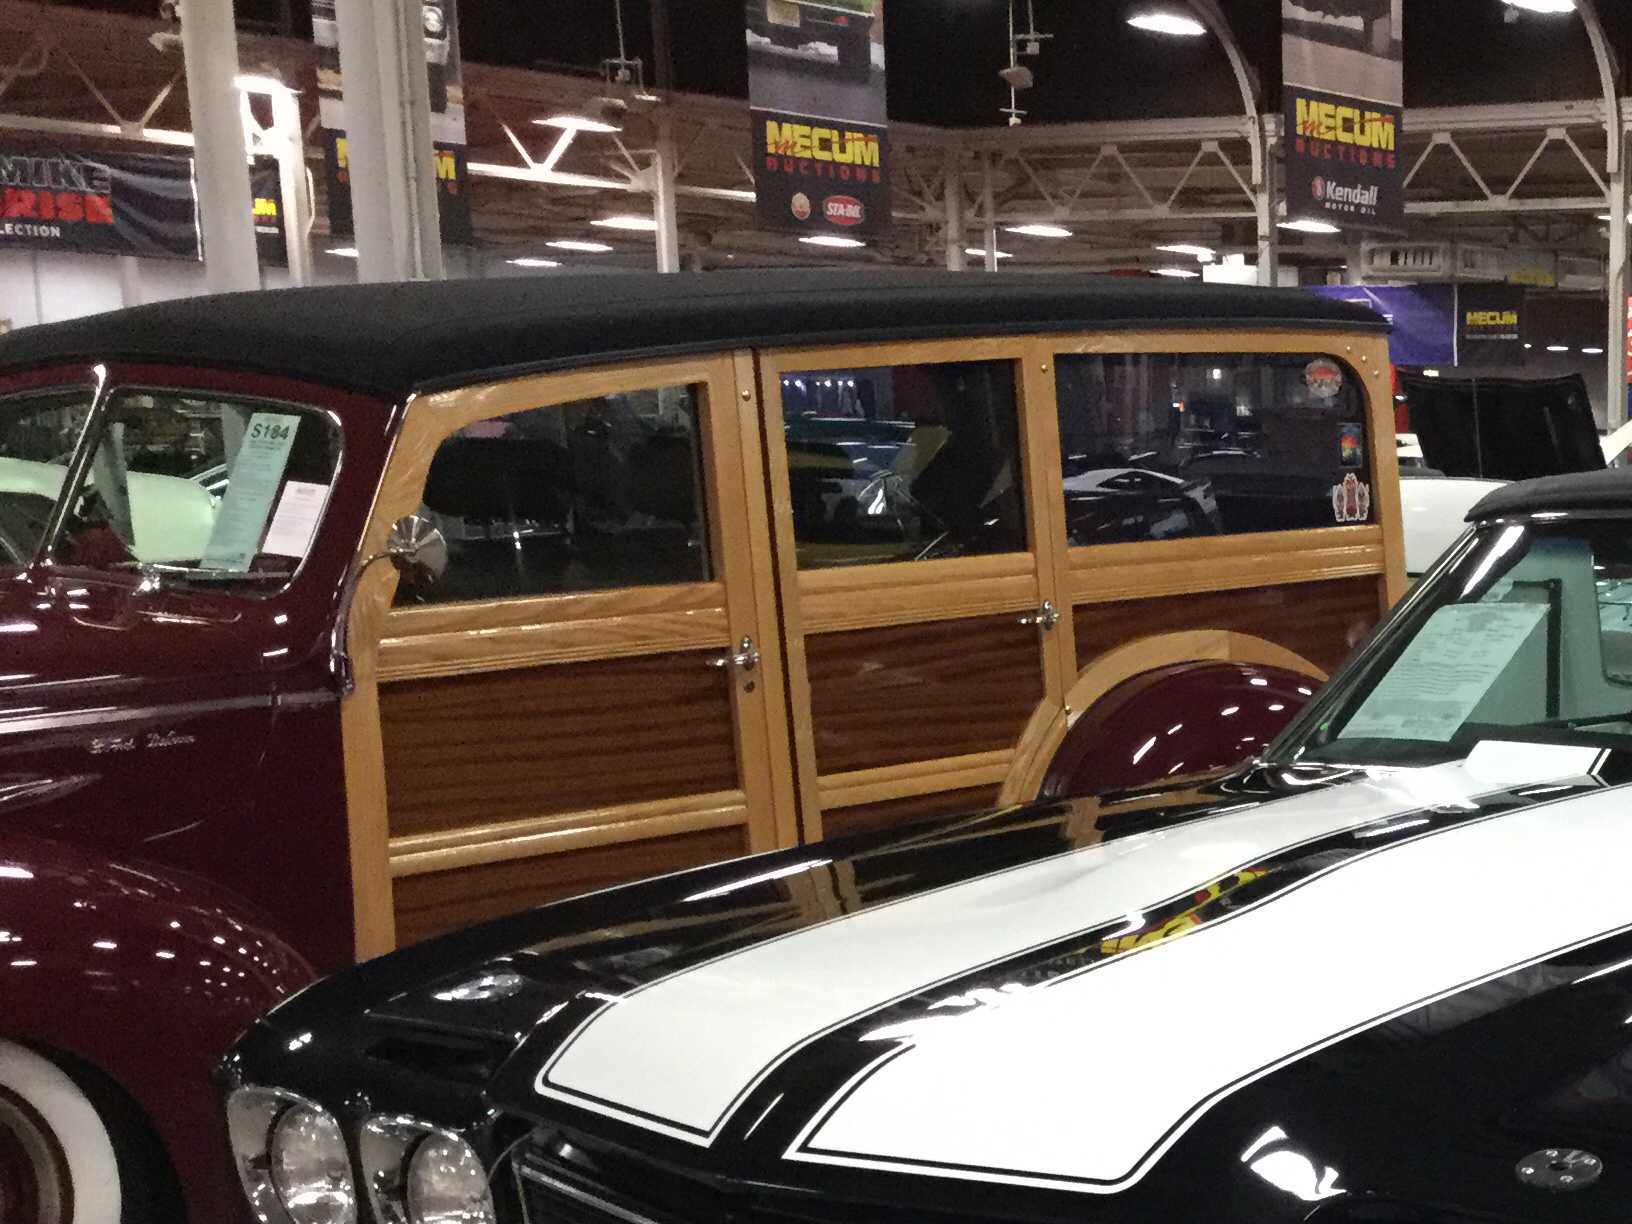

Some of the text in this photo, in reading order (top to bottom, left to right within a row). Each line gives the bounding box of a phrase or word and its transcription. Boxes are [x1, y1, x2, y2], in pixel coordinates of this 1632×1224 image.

[1296, 98, 1395, 151] MECUM
[766, 120, 880, 167] MECUM
[1326, 181, 1378, 205] Kendall
[1466, 311, 1518, 325] MECUM
[251, 423, 290, 440] S184
